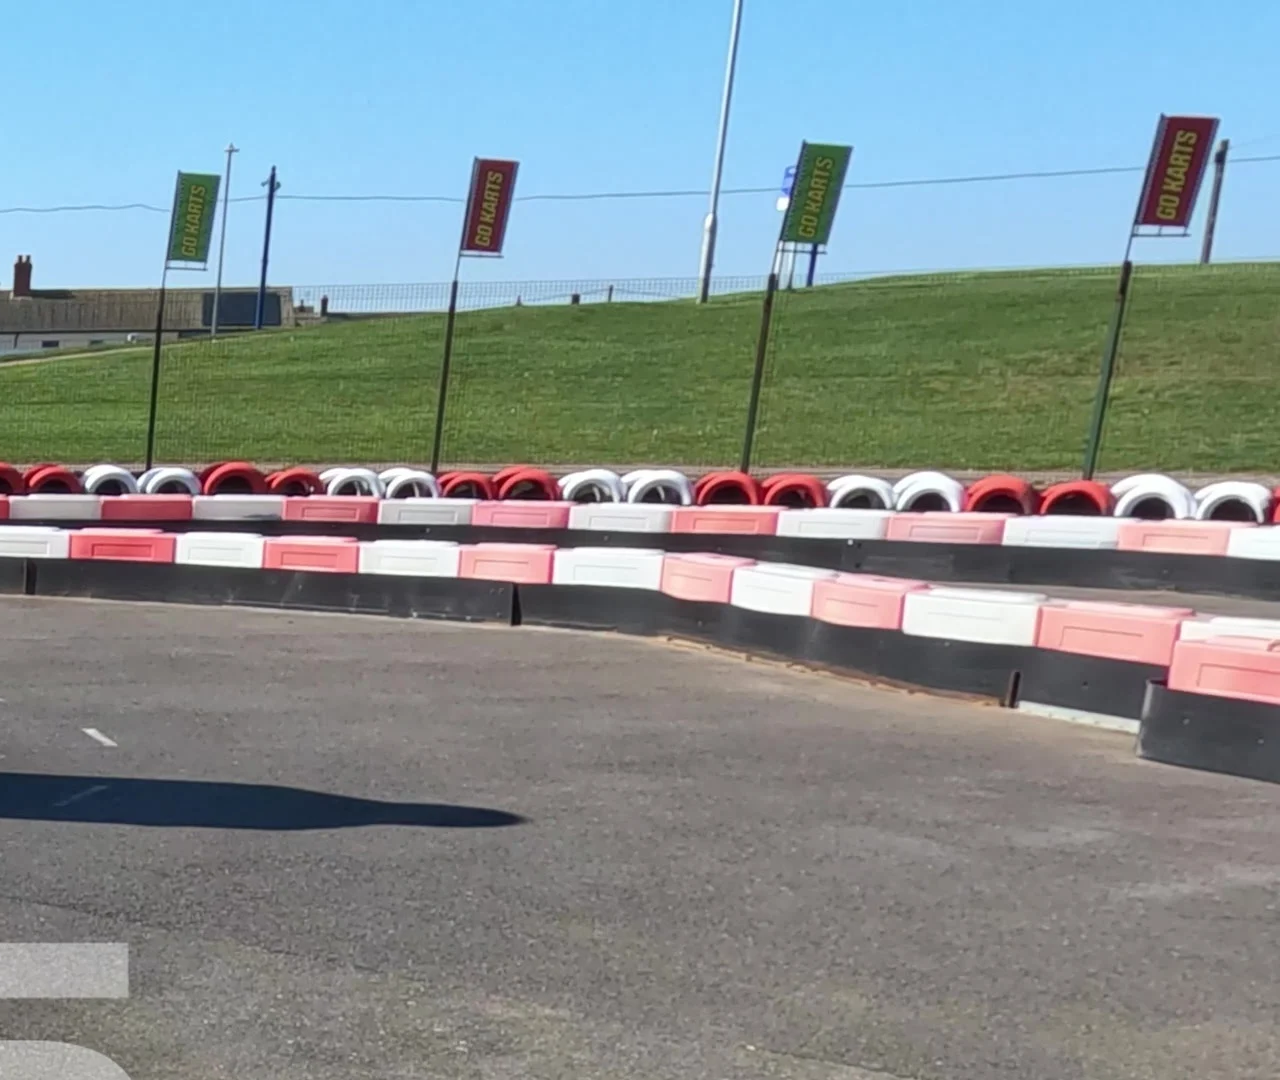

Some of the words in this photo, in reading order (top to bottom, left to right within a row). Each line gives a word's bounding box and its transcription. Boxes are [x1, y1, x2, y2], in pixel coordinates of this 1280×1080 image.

[1162, 130, 1197, 191] KARTS
[186, 185, 205, 234] KARTS
[480, 171, 503, 224] KARTS
[799, 215, 817, 238] GO
[808, 157, 833, 213] KARTS
[1156, 195, 1179, 220] GO
[181, 236, 197, 256] GO
[475, 225, 491, 246] GO
